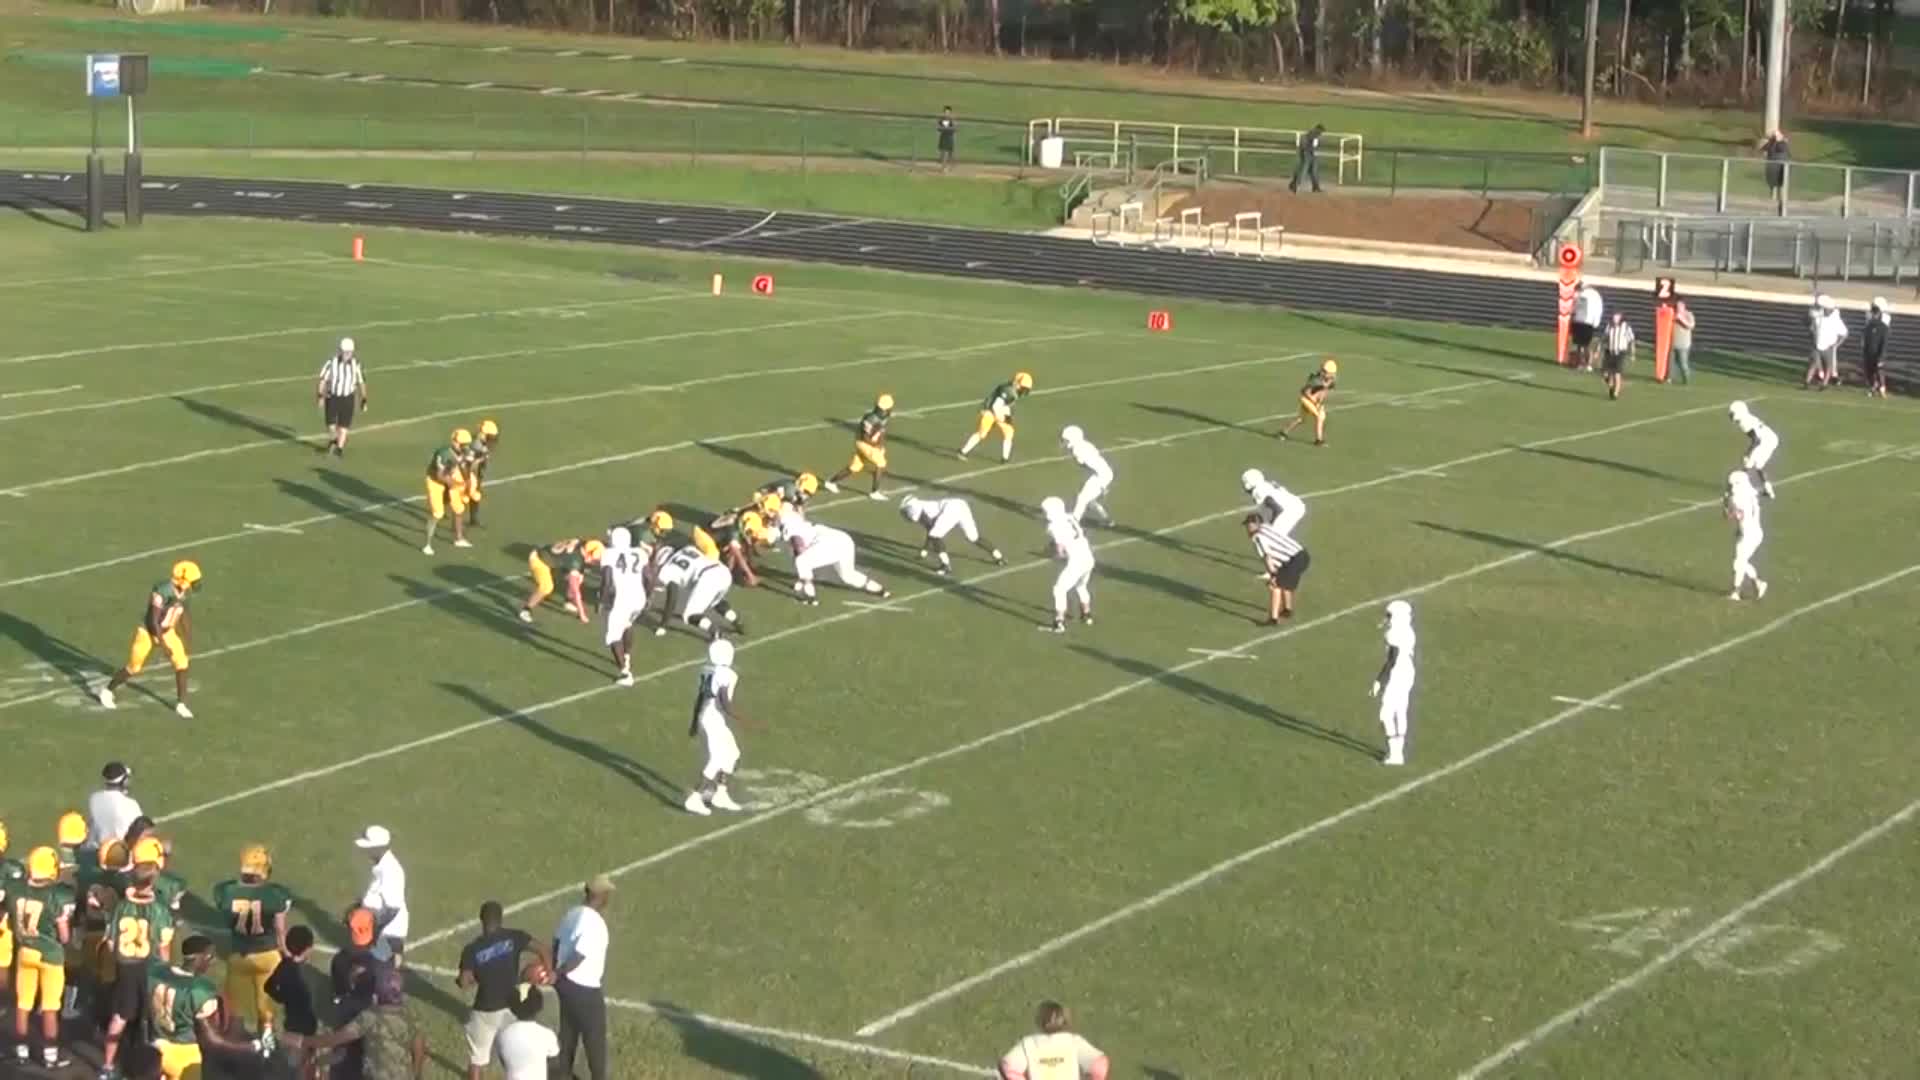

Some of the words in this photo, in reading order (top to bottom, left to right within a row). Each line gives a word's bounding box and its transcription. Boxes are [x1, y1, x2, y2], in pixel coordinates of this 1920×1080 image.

[754, 277, 769, 293] G
[1657, 278, 1672, 298] 2
[1150, 313, 1165, 328] 10
[615, 552, 641, 575] 42
[16, 897, 43, 937] 17
[231, 899, 265, 935] 71
